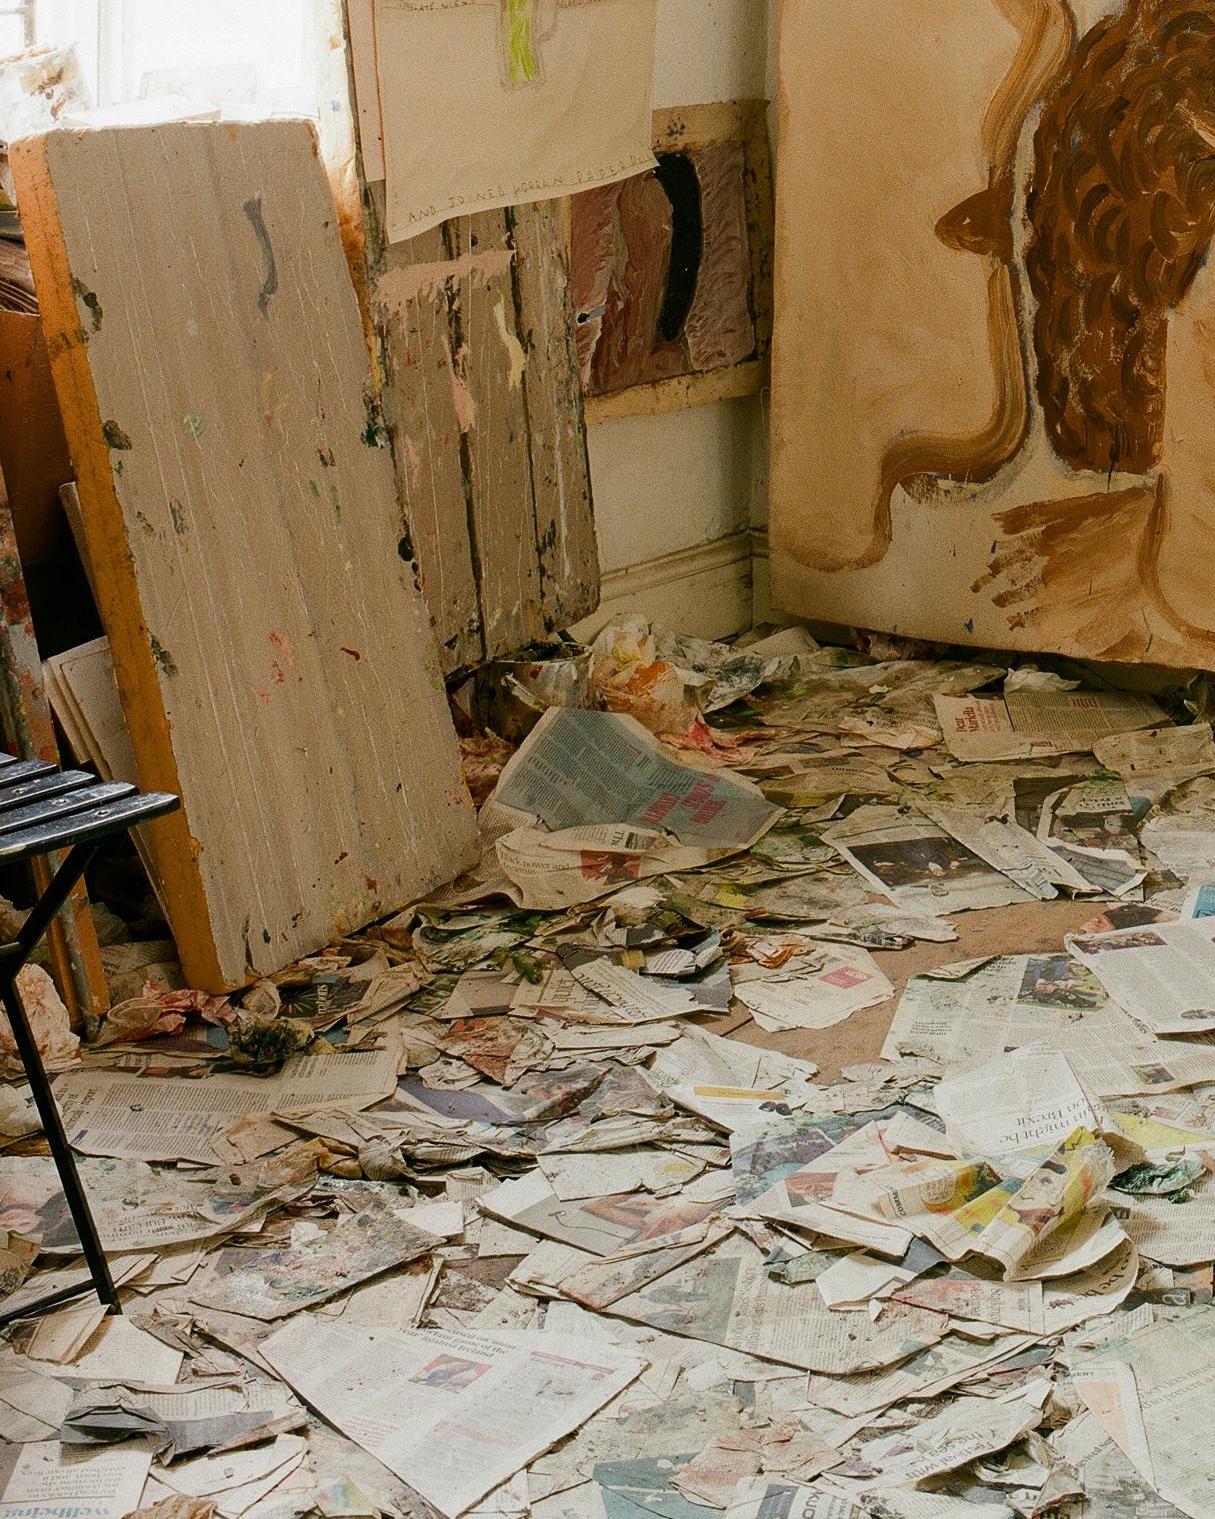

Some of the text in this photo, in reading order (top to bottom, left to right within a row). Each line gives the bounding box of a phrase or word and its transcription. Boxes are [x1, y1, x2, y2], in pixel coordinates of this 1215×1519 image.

[407, 205, 437, 224] AND
[1015, 1108, 1063, 1128] Brexit
[998, 1132, 1020, 1143] be
[1024, 1120, 1069, 1138] might
[4, 1506, 113, 1519] wellbeing
